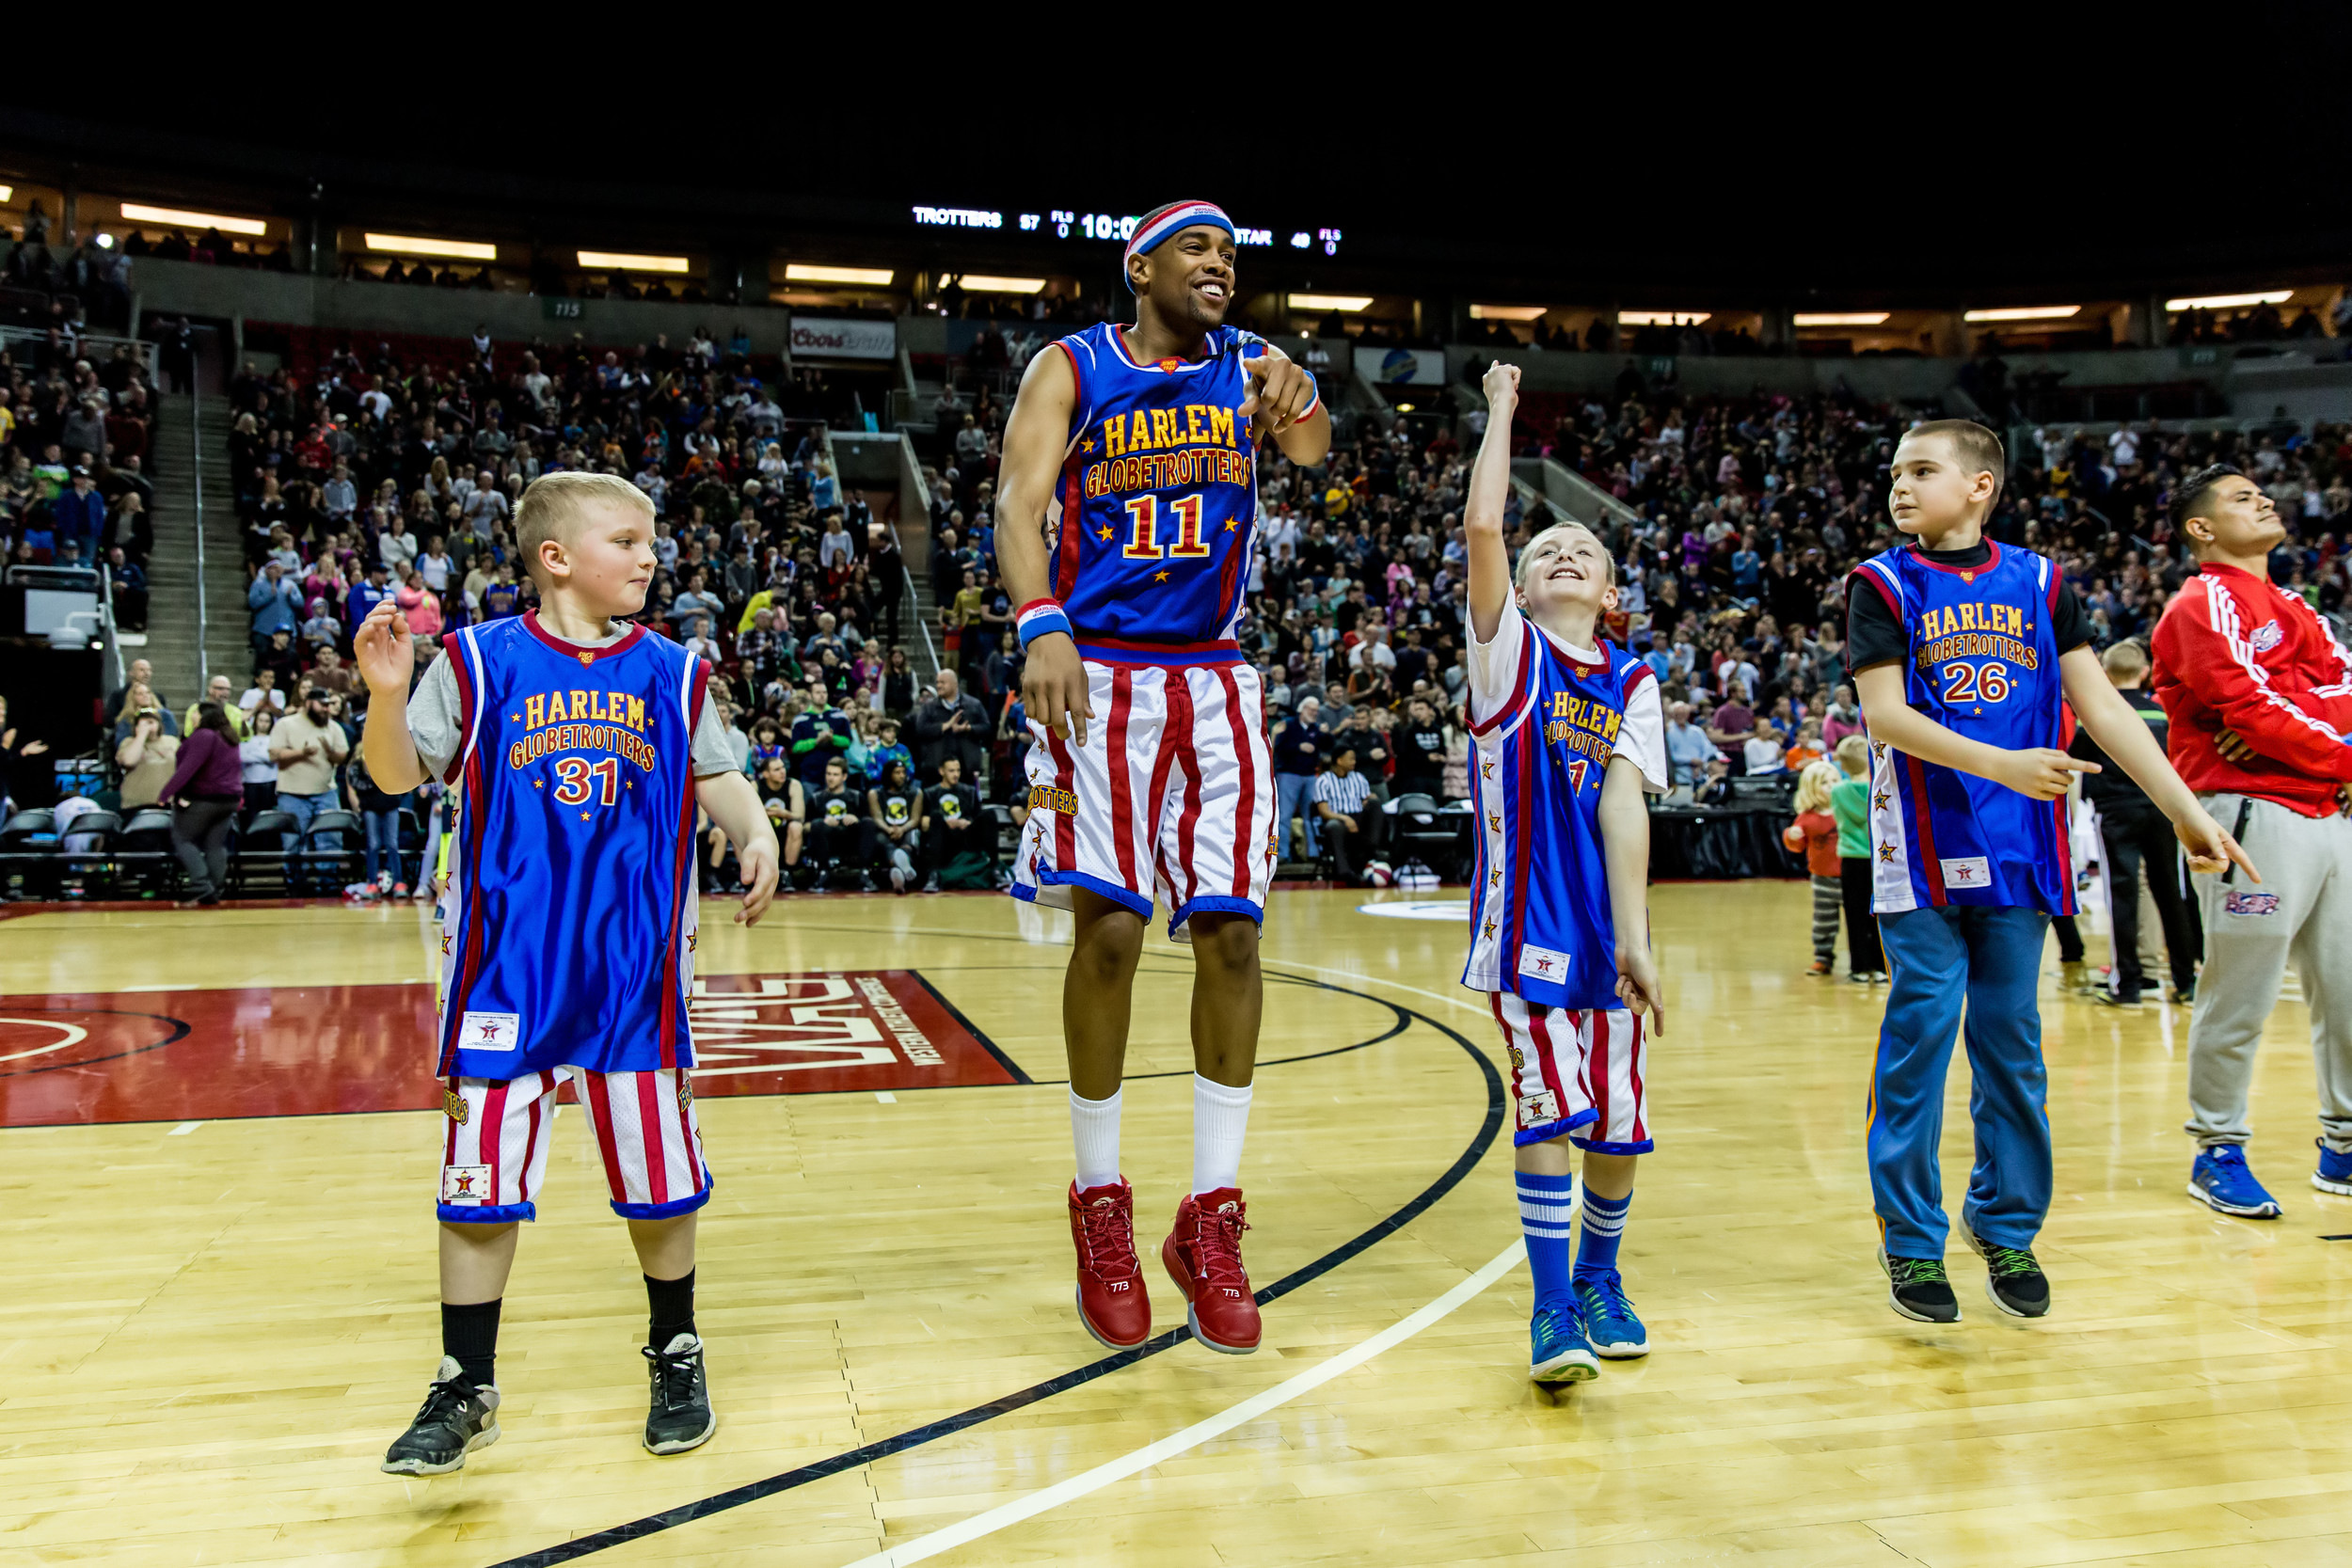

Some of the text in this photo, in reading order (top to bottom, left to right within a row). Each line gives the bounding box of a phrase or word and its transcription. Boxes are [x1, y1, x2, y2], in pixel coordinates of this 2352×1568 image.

[913, 206, 1003, 228] TROTTERS
[1051, 210, 1074, 224] FLS
[1081, 213, 1142, 241] 10:0
[1104, 404, 1237, 458] HARLEM
[1085, 448, 1251, 499] GLOBETROTTERS
[1122, 494, 1211, 560] 11
[1921, 602, 2024, 641] HARLEM
[1915, 633, 2039, 670] GLOBETROTTERS
[1943, 661, 2010, 704] 26
[525, 690, 645, 733] HARLEM
[1552, 691, 1623, 743] HRLEM
[509, 724, 656, 772] GLOBETROTTERS
[553, 756, 618, 806] 31
[1110, 1280, 1130, 1293] 773
[1222, 1288, 1240, 1298] 773
